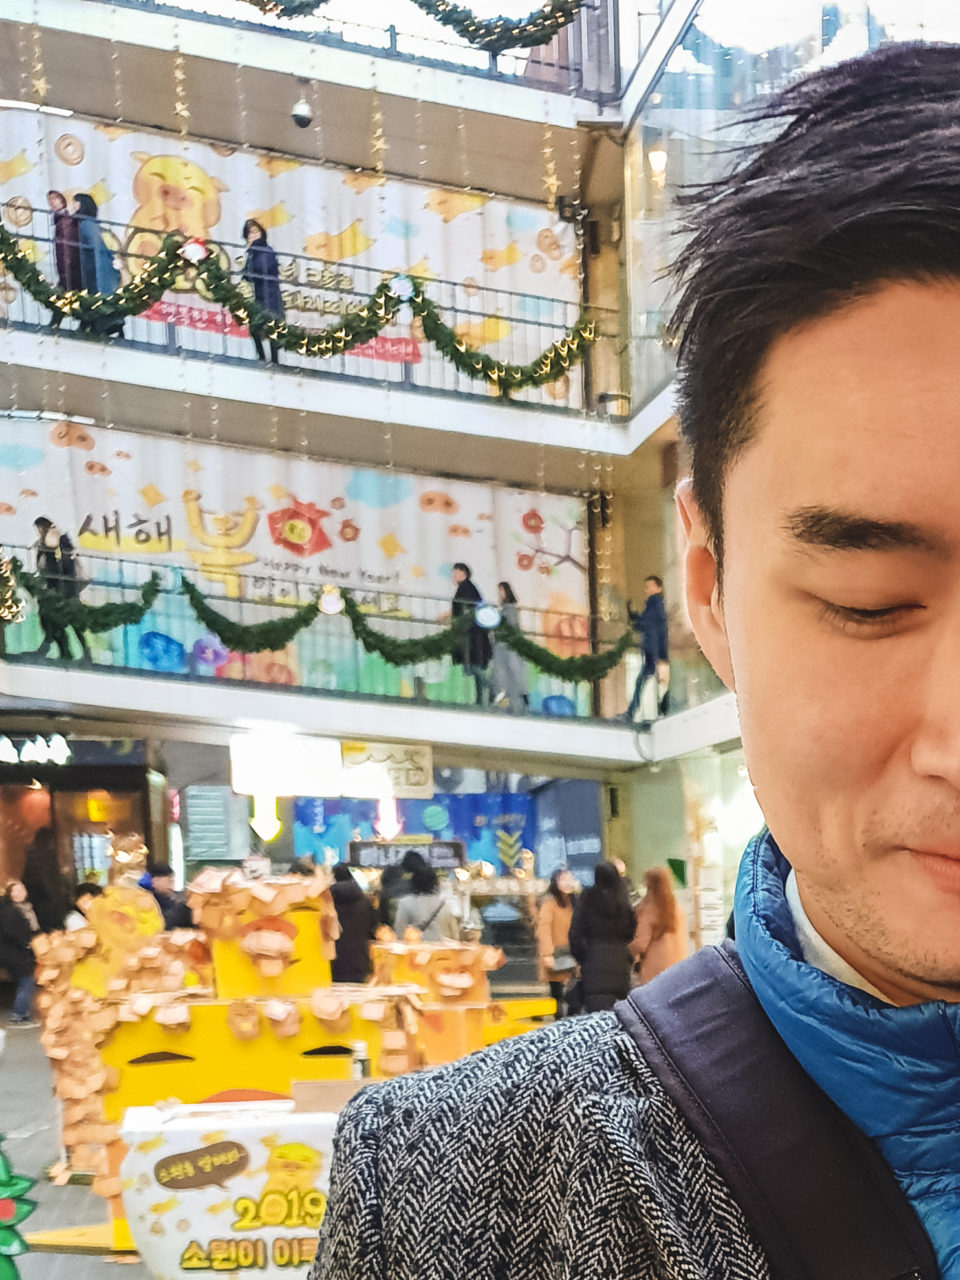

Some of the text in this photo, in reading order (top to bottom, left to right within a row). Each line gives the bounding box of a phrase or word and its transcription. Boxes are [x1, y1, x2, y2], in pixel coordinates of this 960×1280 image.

[79, 510, 172, 551] 새해
[233, 1189, 327, 1230] 2019
[181, 1239, 265, 1270] 소원이
